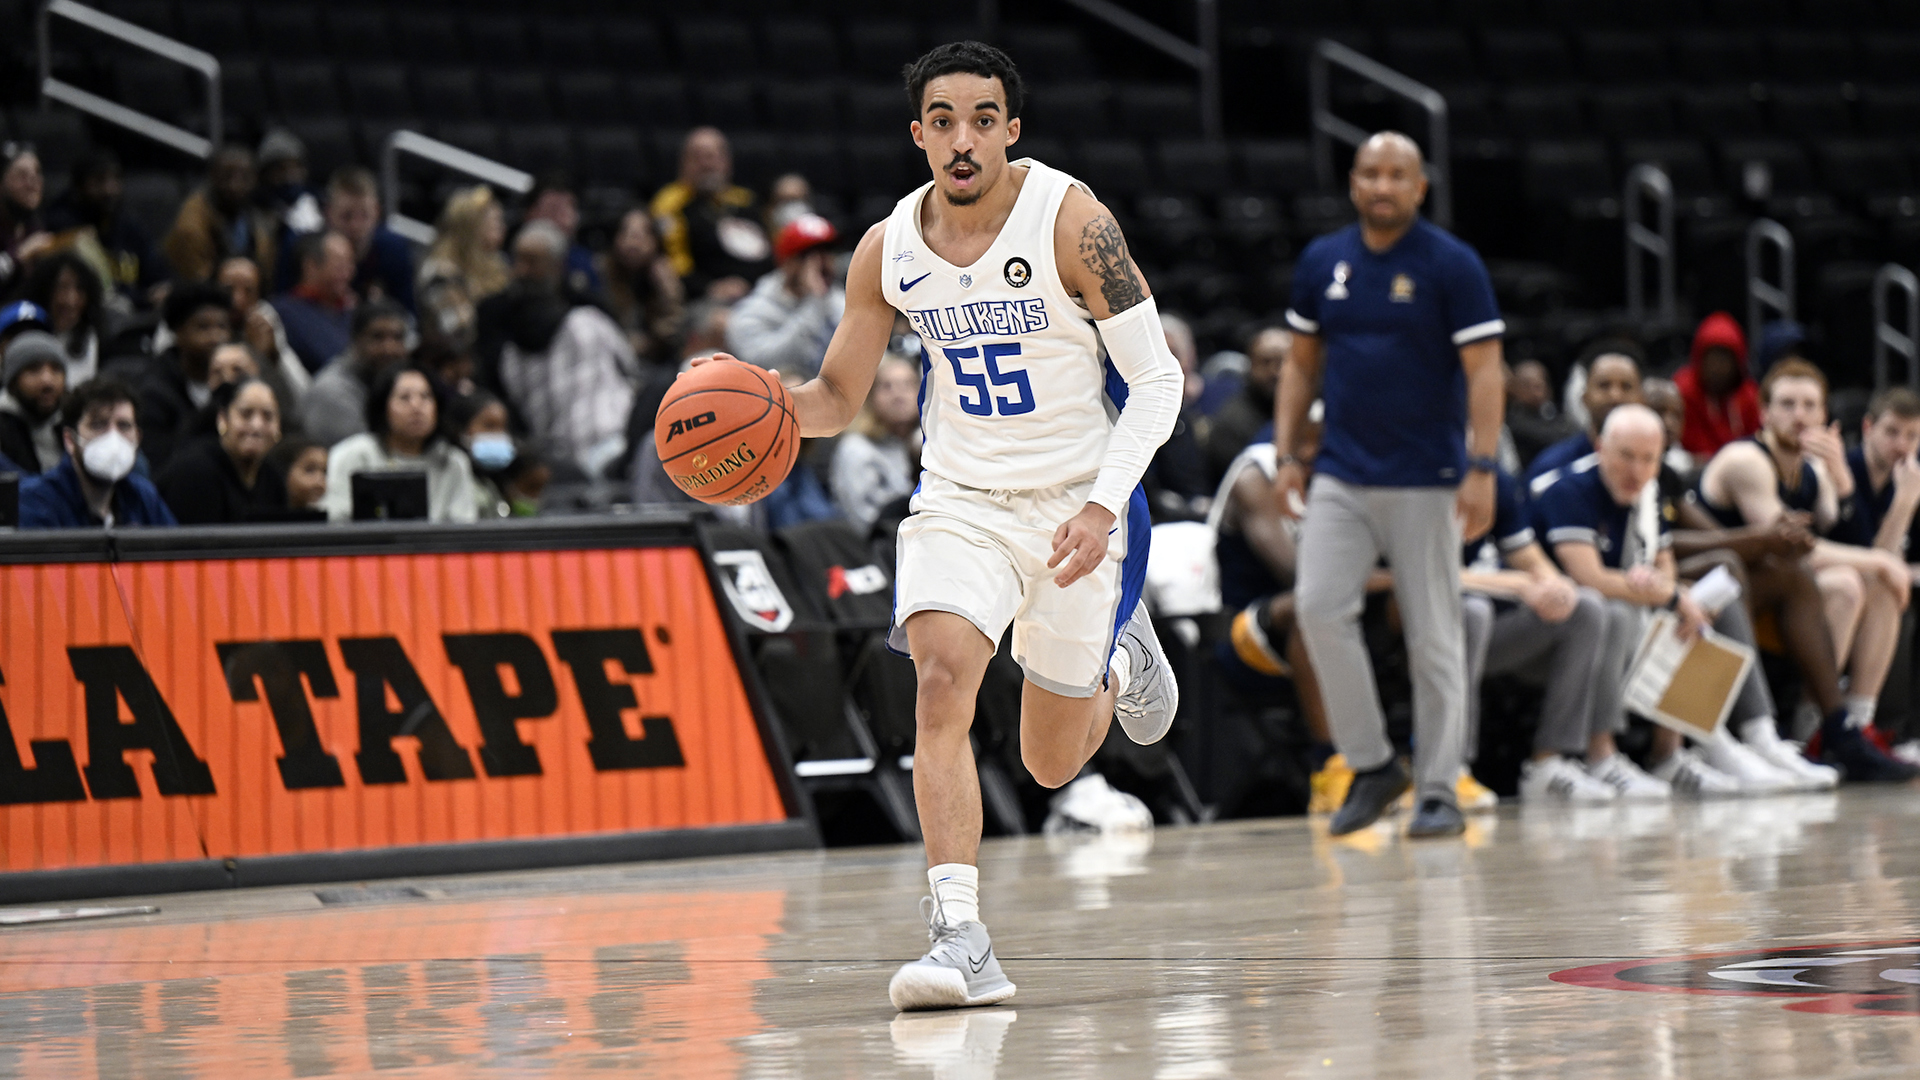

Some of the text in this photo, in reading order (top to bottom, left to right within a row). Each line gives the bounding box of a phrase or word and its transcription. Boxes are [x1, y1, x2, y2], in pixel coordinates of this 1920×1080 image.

[906, 298, 1049, 341] BILLIKENS
[942, 342, 1036, 416] 55
[673, 441, 757, 490] SPALDING
[214, 627, 687, 790] TAPE
